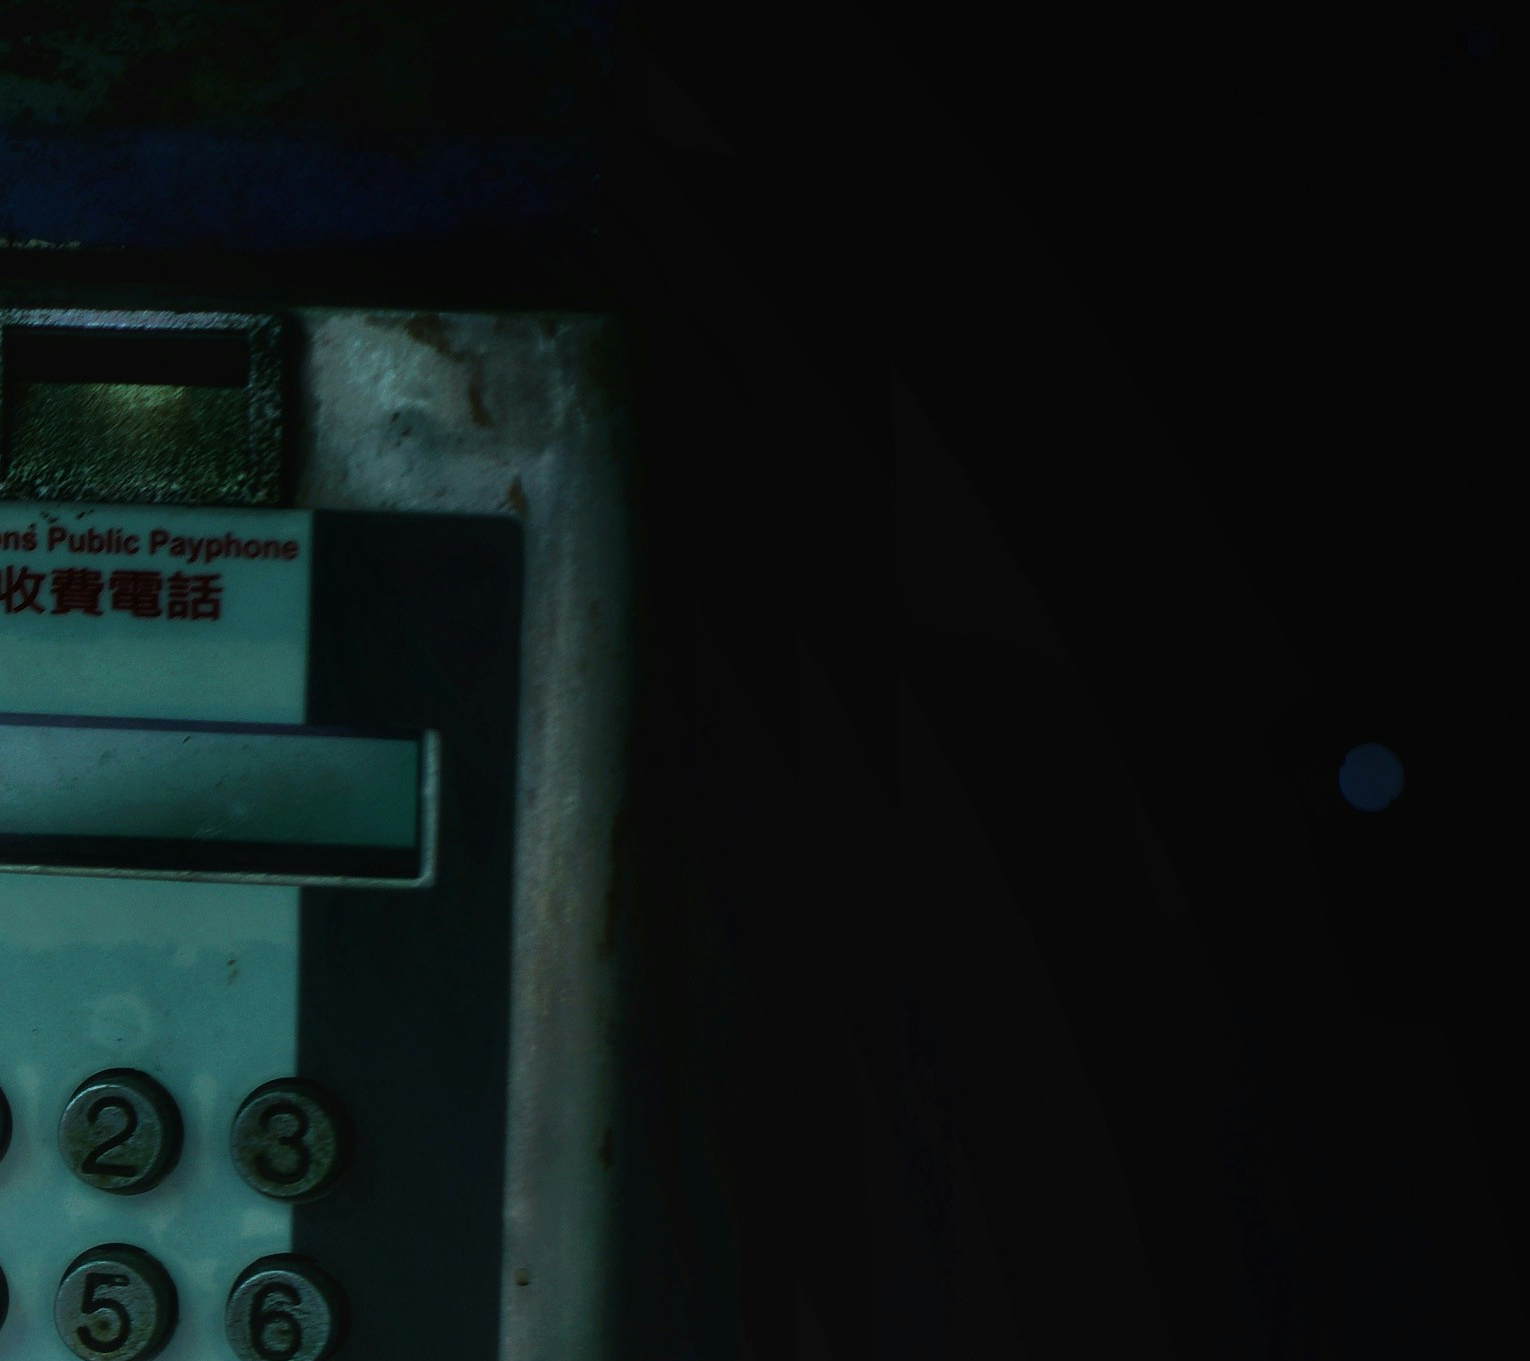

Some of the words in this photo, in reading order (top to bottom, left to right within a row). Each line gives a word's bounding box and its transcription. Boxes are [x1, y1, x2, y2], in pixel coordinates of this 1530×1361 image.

[48, 525, 139, 557] Public
[150, 530, 299, 564] Payphone
[80, 1096, 138, 1178] 2
[253, 1102, 309, 1185] 3
[77, 1272, 130, 1354] 5
